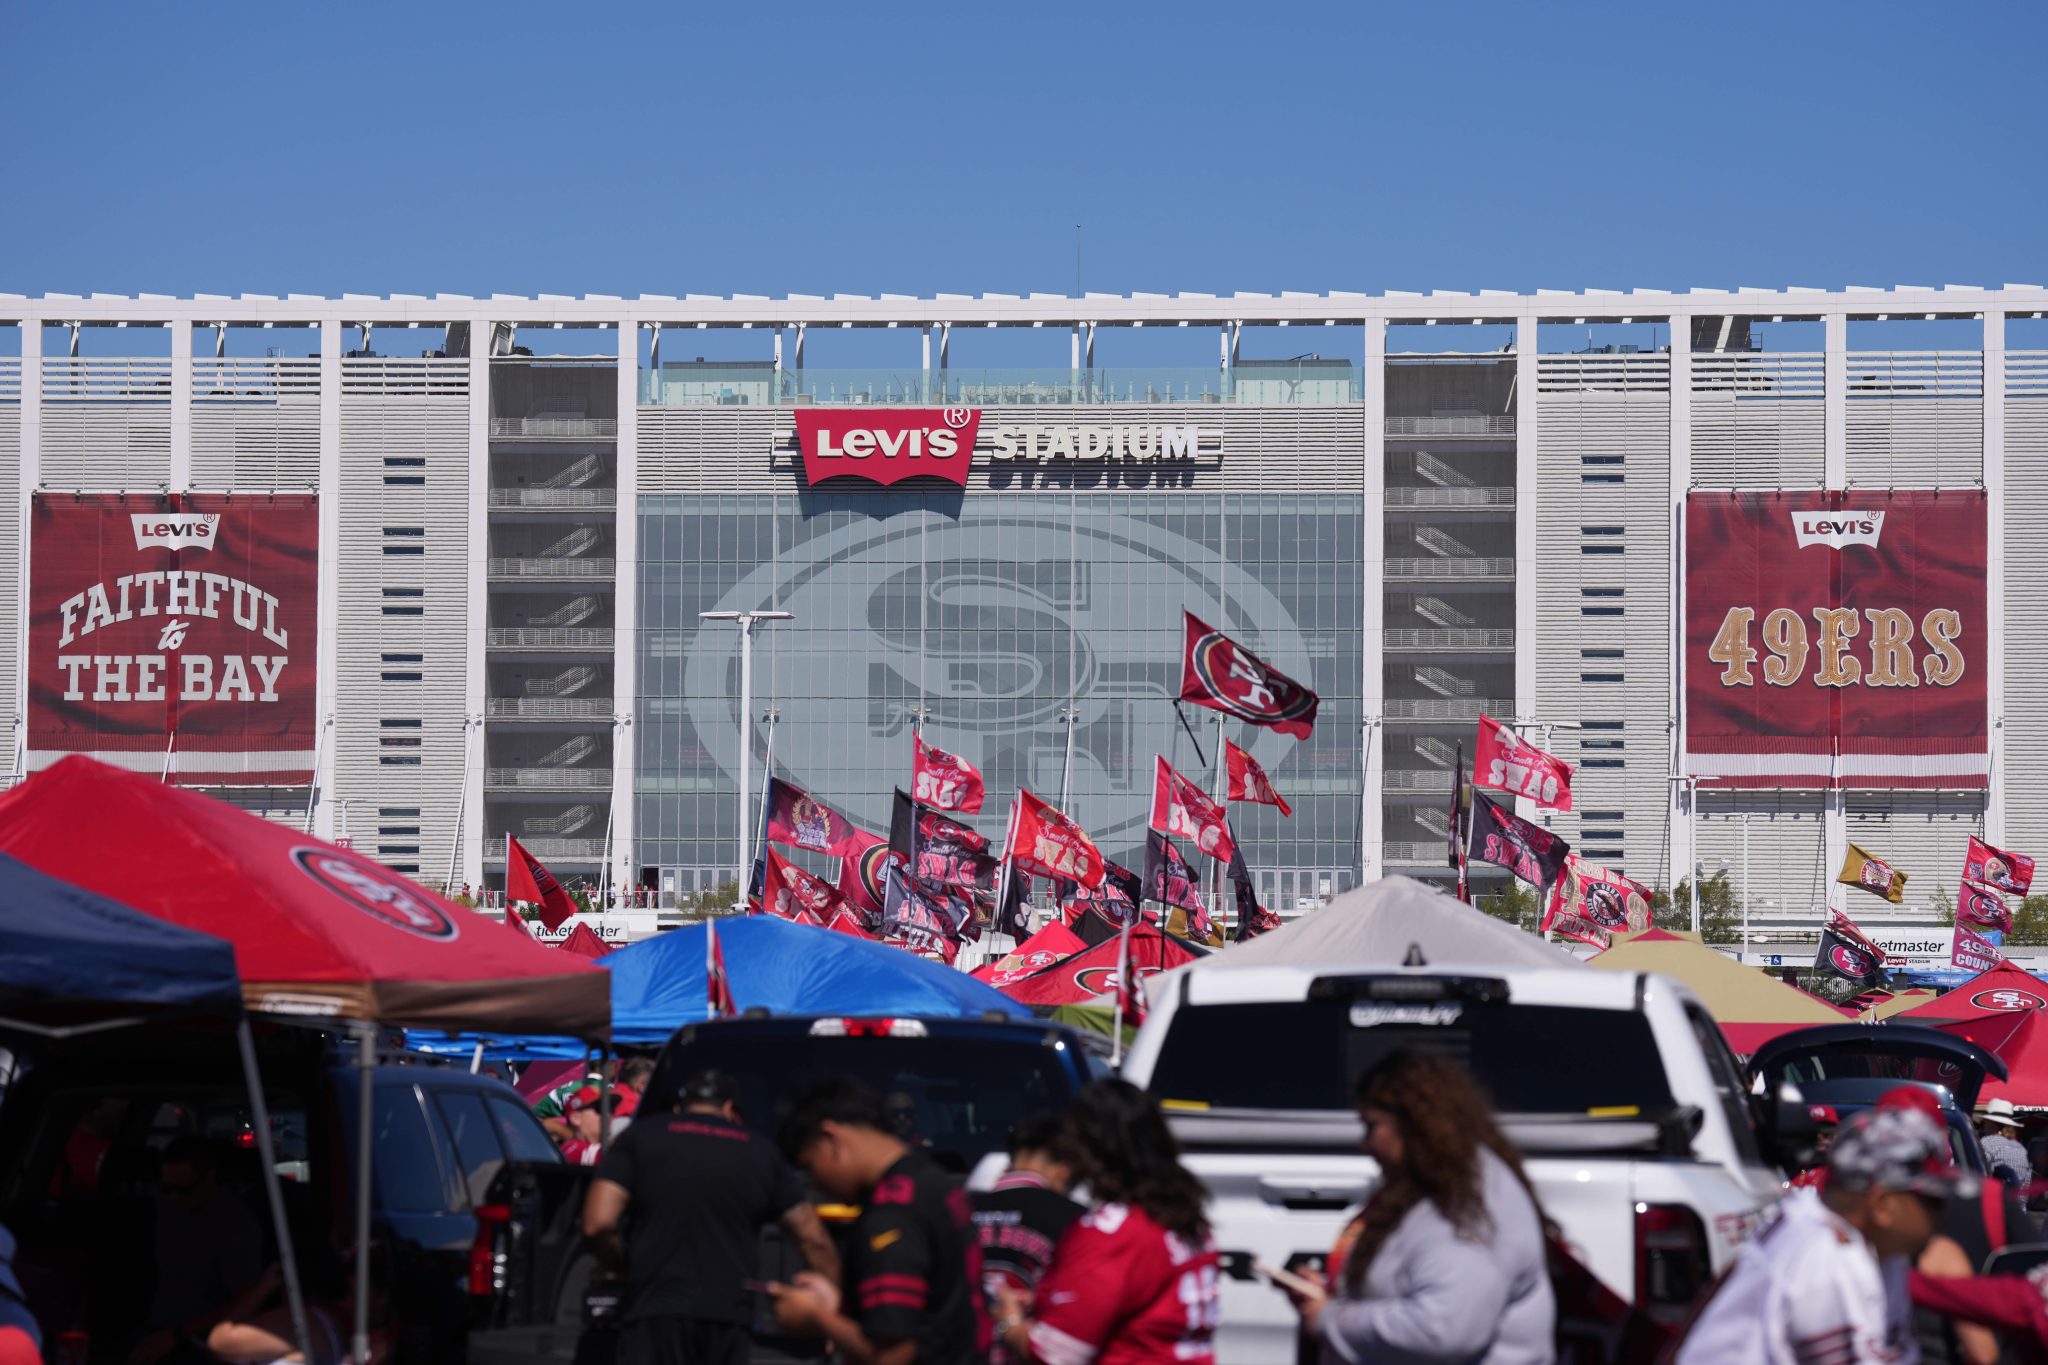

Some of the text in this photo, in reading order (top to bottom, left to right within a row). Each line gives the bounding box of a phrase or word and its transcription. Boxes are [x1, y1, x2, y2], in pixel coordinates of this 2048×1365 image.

[992, 425, 1198, 459] STADIUM
[58, 570, 288, 650] FAITHFUL
[157, 618, 190, 650] to
[1708, 606, 1965, 688] 49ERS
[58, 655, 288, 702] THE BAY
[536, 924, 620, 938] ticketster
